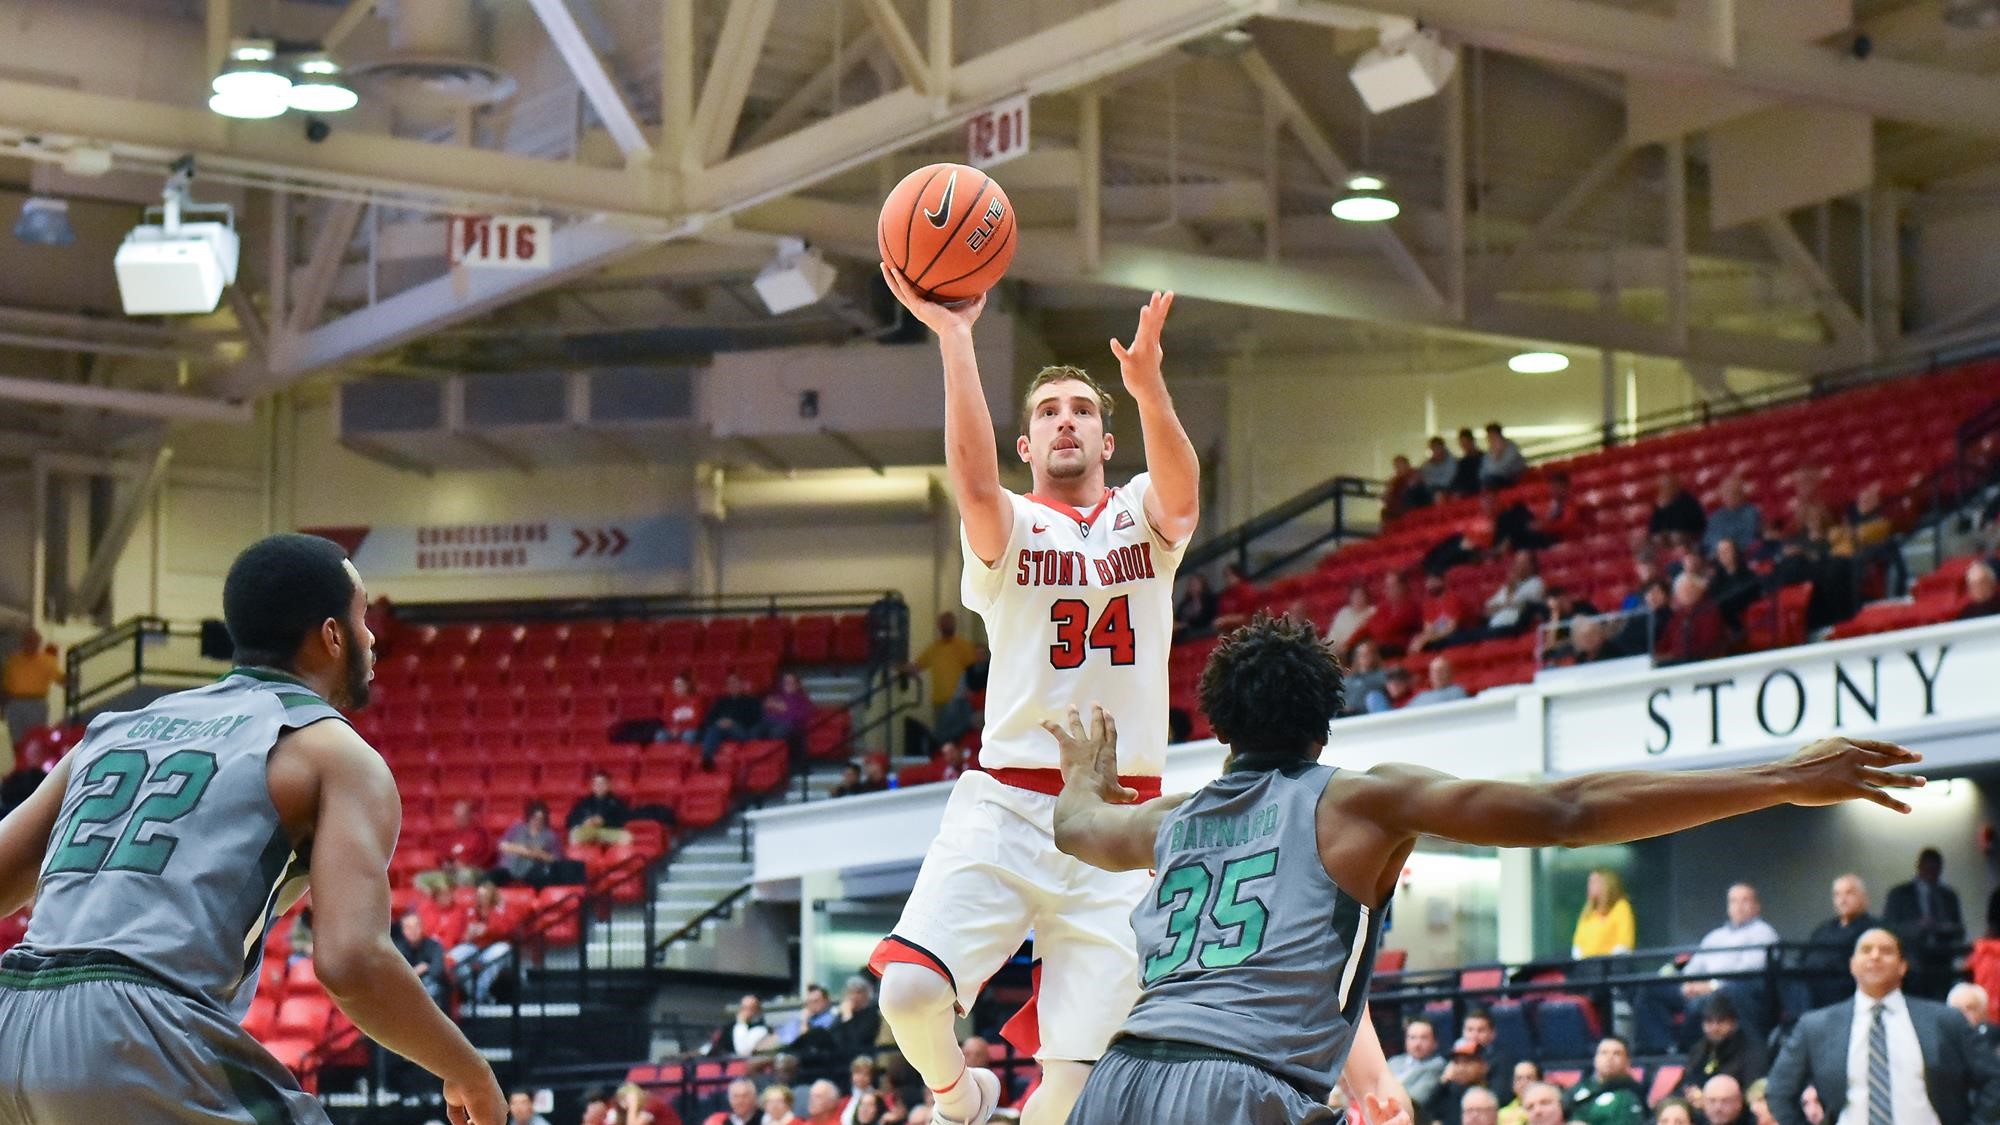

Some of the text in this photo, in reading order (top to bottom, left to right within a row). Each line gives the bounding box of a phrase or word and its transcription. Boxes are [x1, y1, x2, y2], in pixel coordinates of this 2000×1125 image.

[480, 223, 536, 260] 116
[966, 197, 1005, 252] ELITE
[1093, 542, 1155, 586] BROOK
[1050, 594, 1135, 669] 34
[1646, 642, 1952, 755] STONY
[127, 714, 253, 742] GREGORY
[42, 748, 219, 877] 22
[1171, 803, 1279, 853] BARNARD
[1143, 847, 1279, 986] 35
